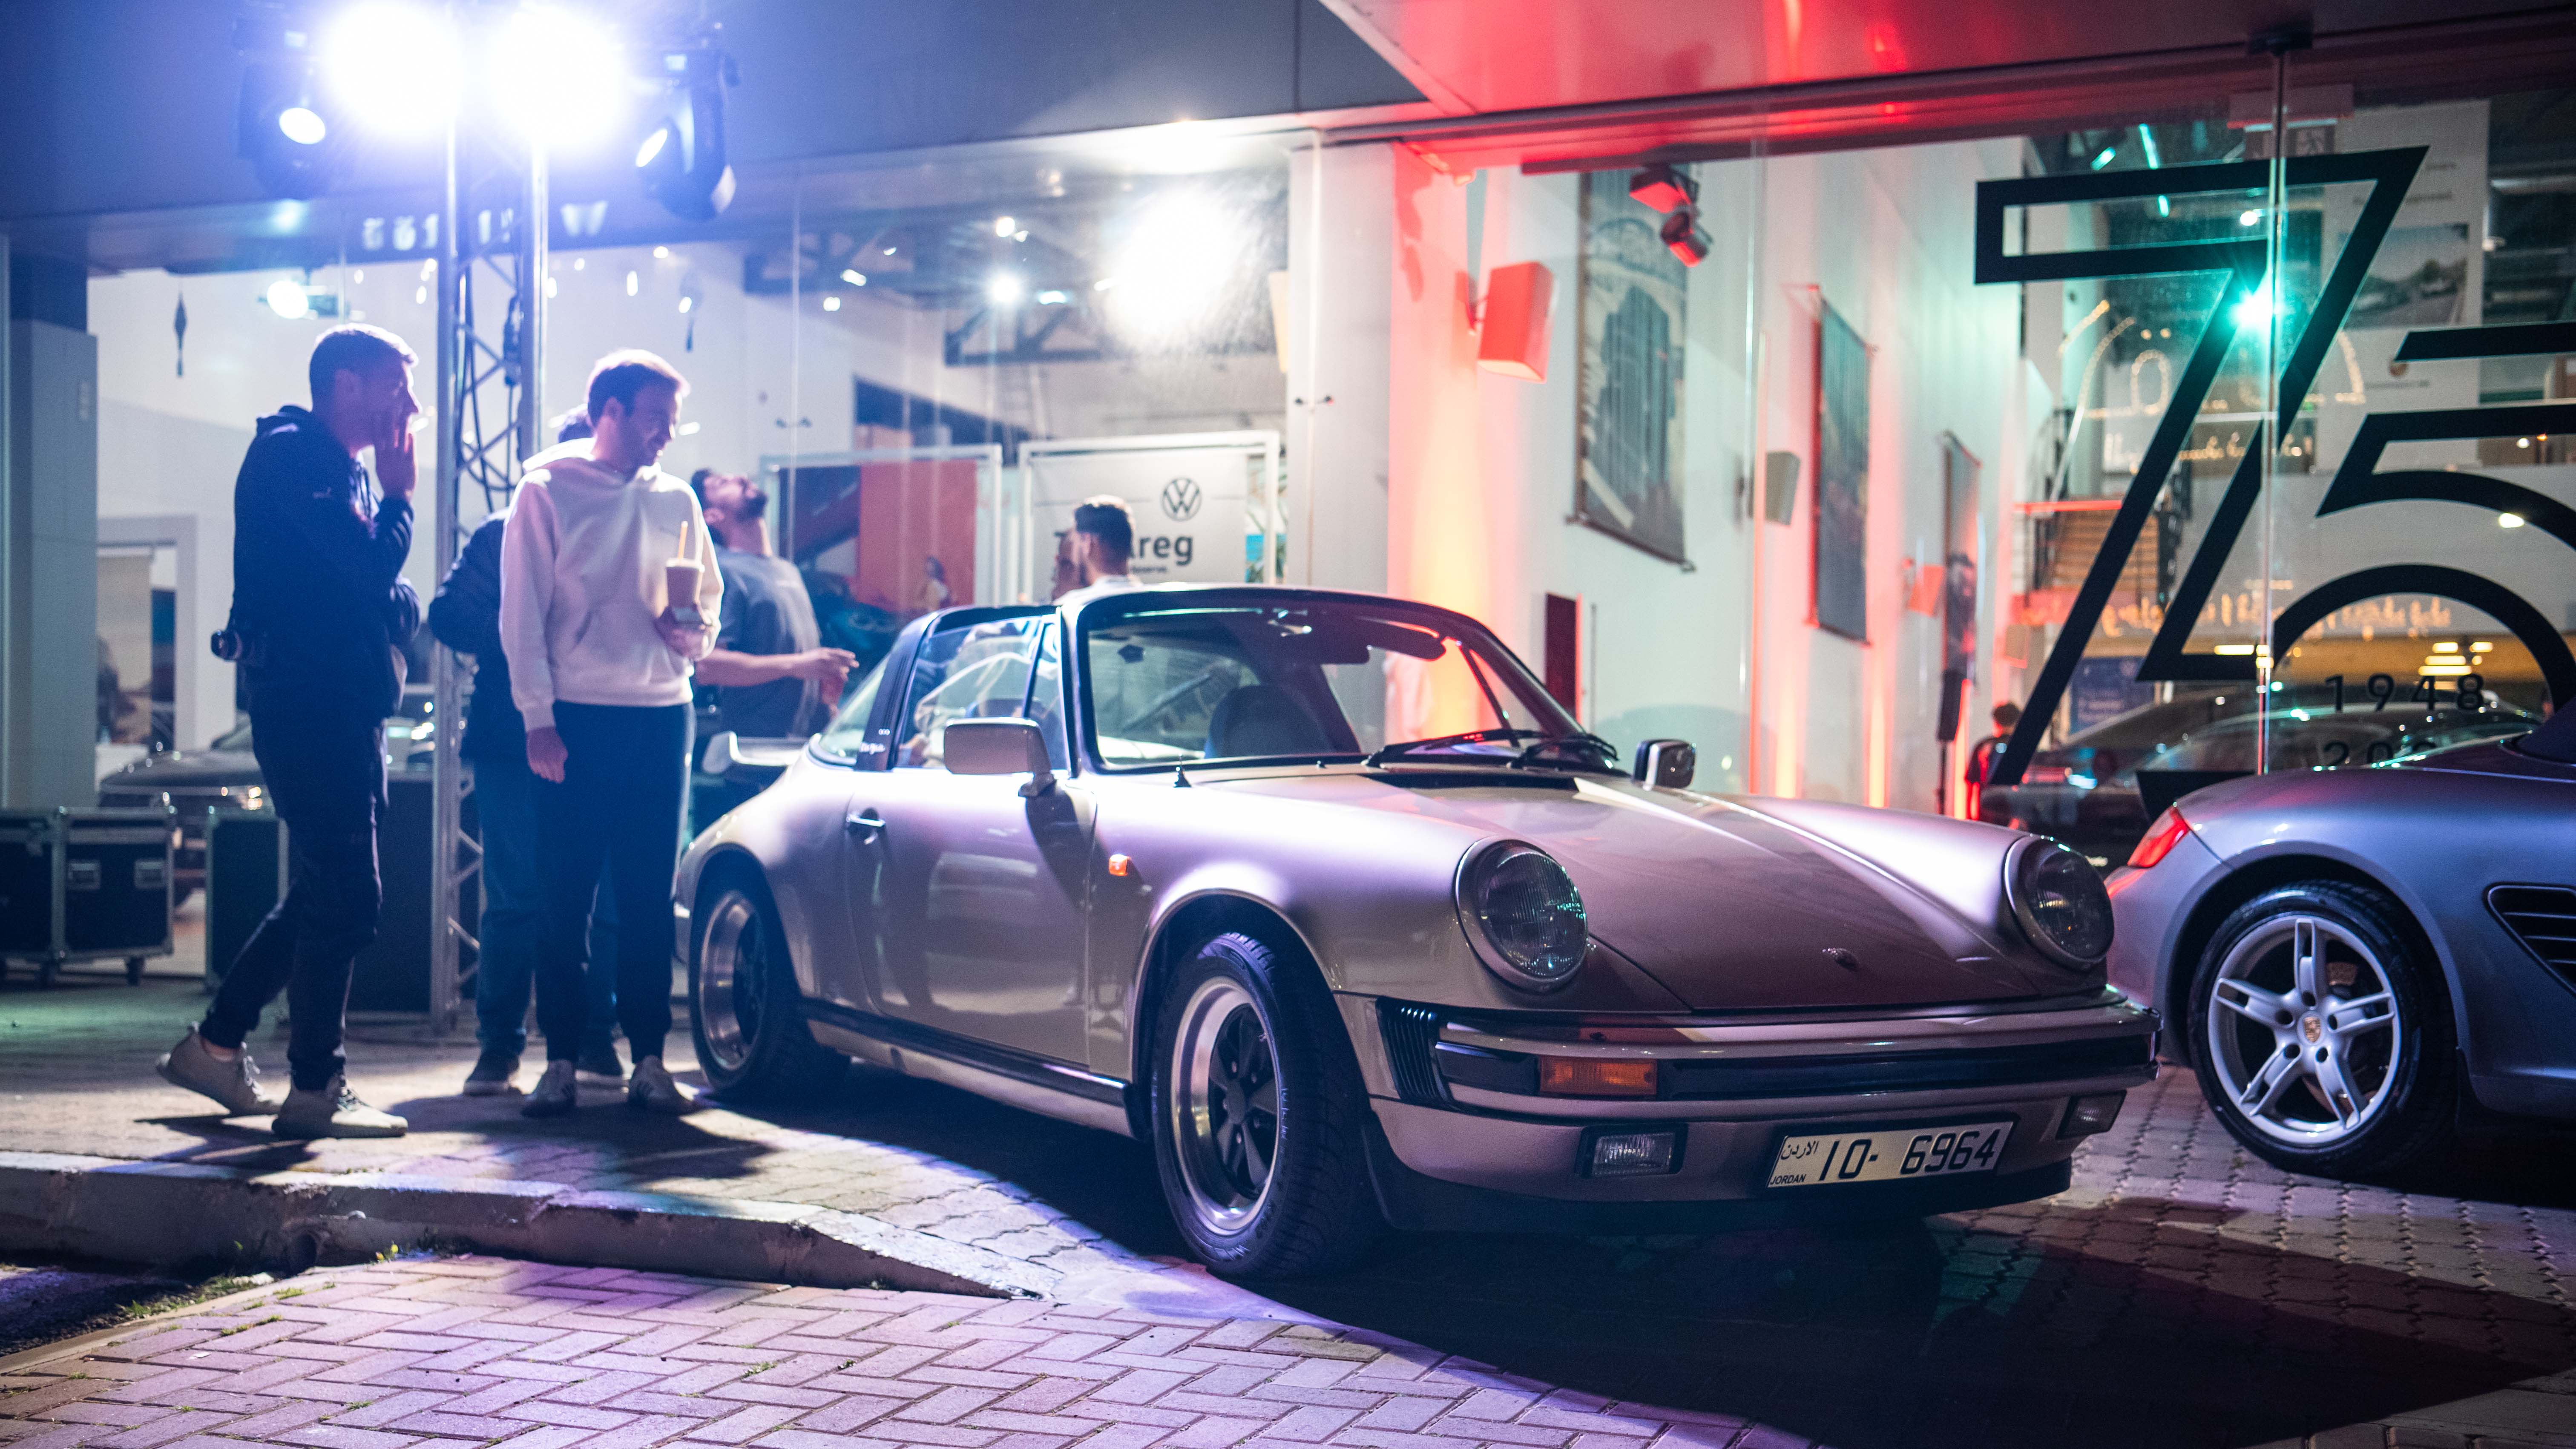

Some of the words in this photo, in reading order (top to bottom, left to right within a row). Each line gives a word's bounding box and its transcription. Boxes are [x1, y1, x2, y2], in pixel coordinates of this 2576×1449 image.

[1129, 535, 1193, 566] reg
[2326, 673, 2484, 711] 1948
[1900, 1129, 2001, 1175] 6964
[1770, 1174, 1806, 1184] JORDAN
